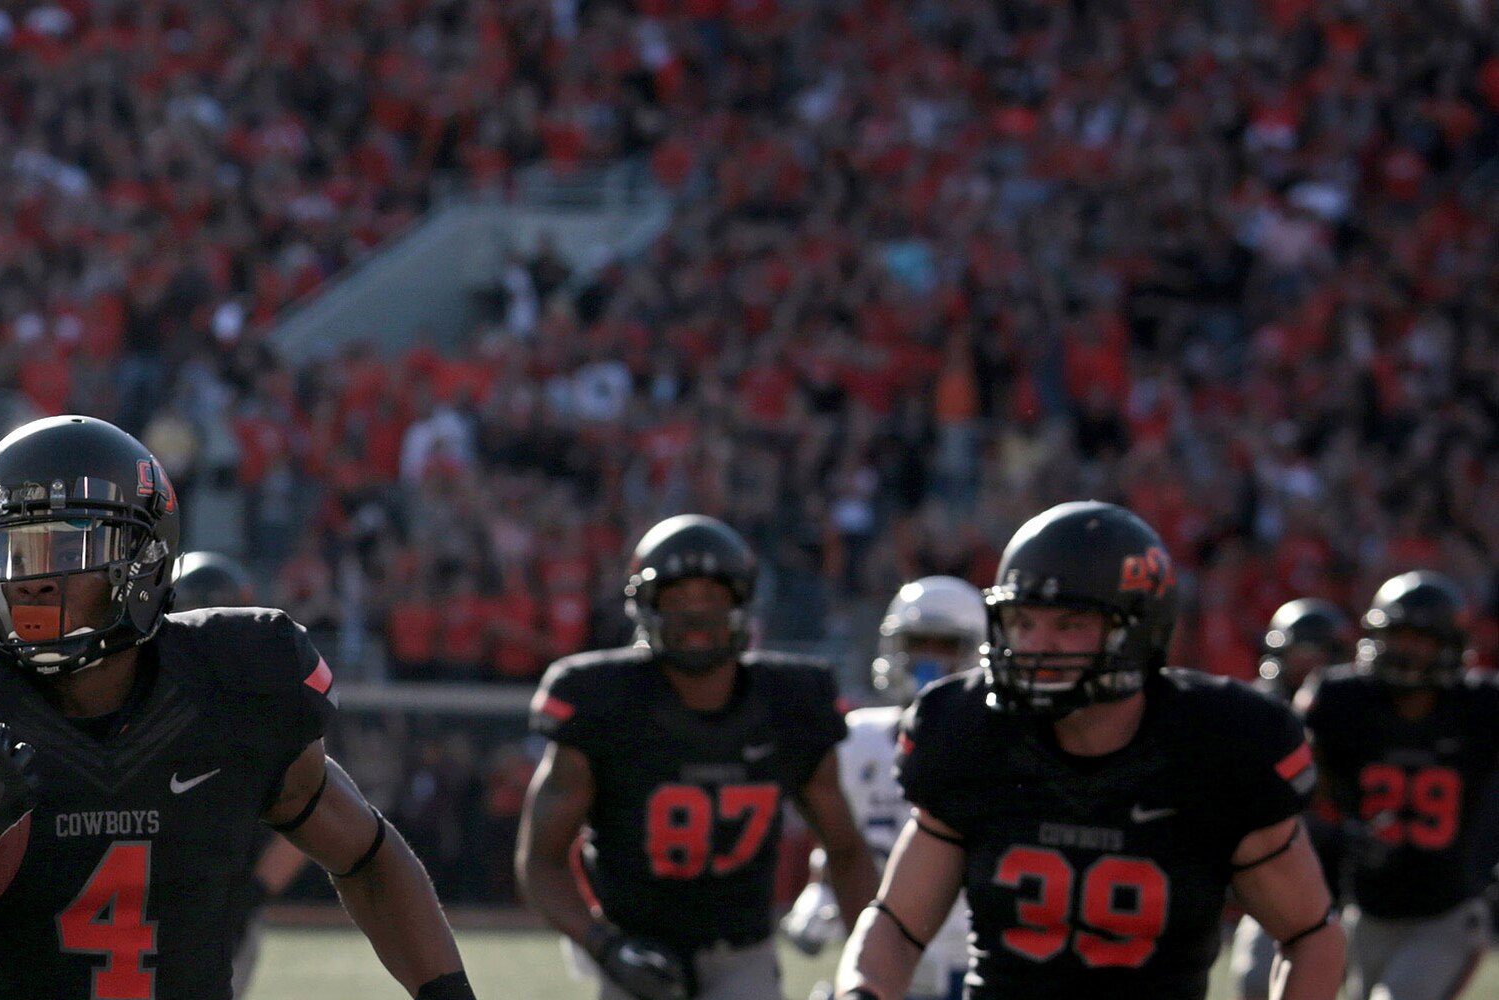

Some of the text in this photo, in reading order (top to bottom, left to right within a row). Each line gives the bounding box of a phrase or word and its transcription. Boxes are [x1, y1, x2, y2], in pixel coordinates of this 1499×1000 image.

[55, 809, 161, 838] COWBOYS
[645, 783, 780, 879] 87
[1359, 763, 1461, 849] 29
[993, 845, 1169, 969] 39
